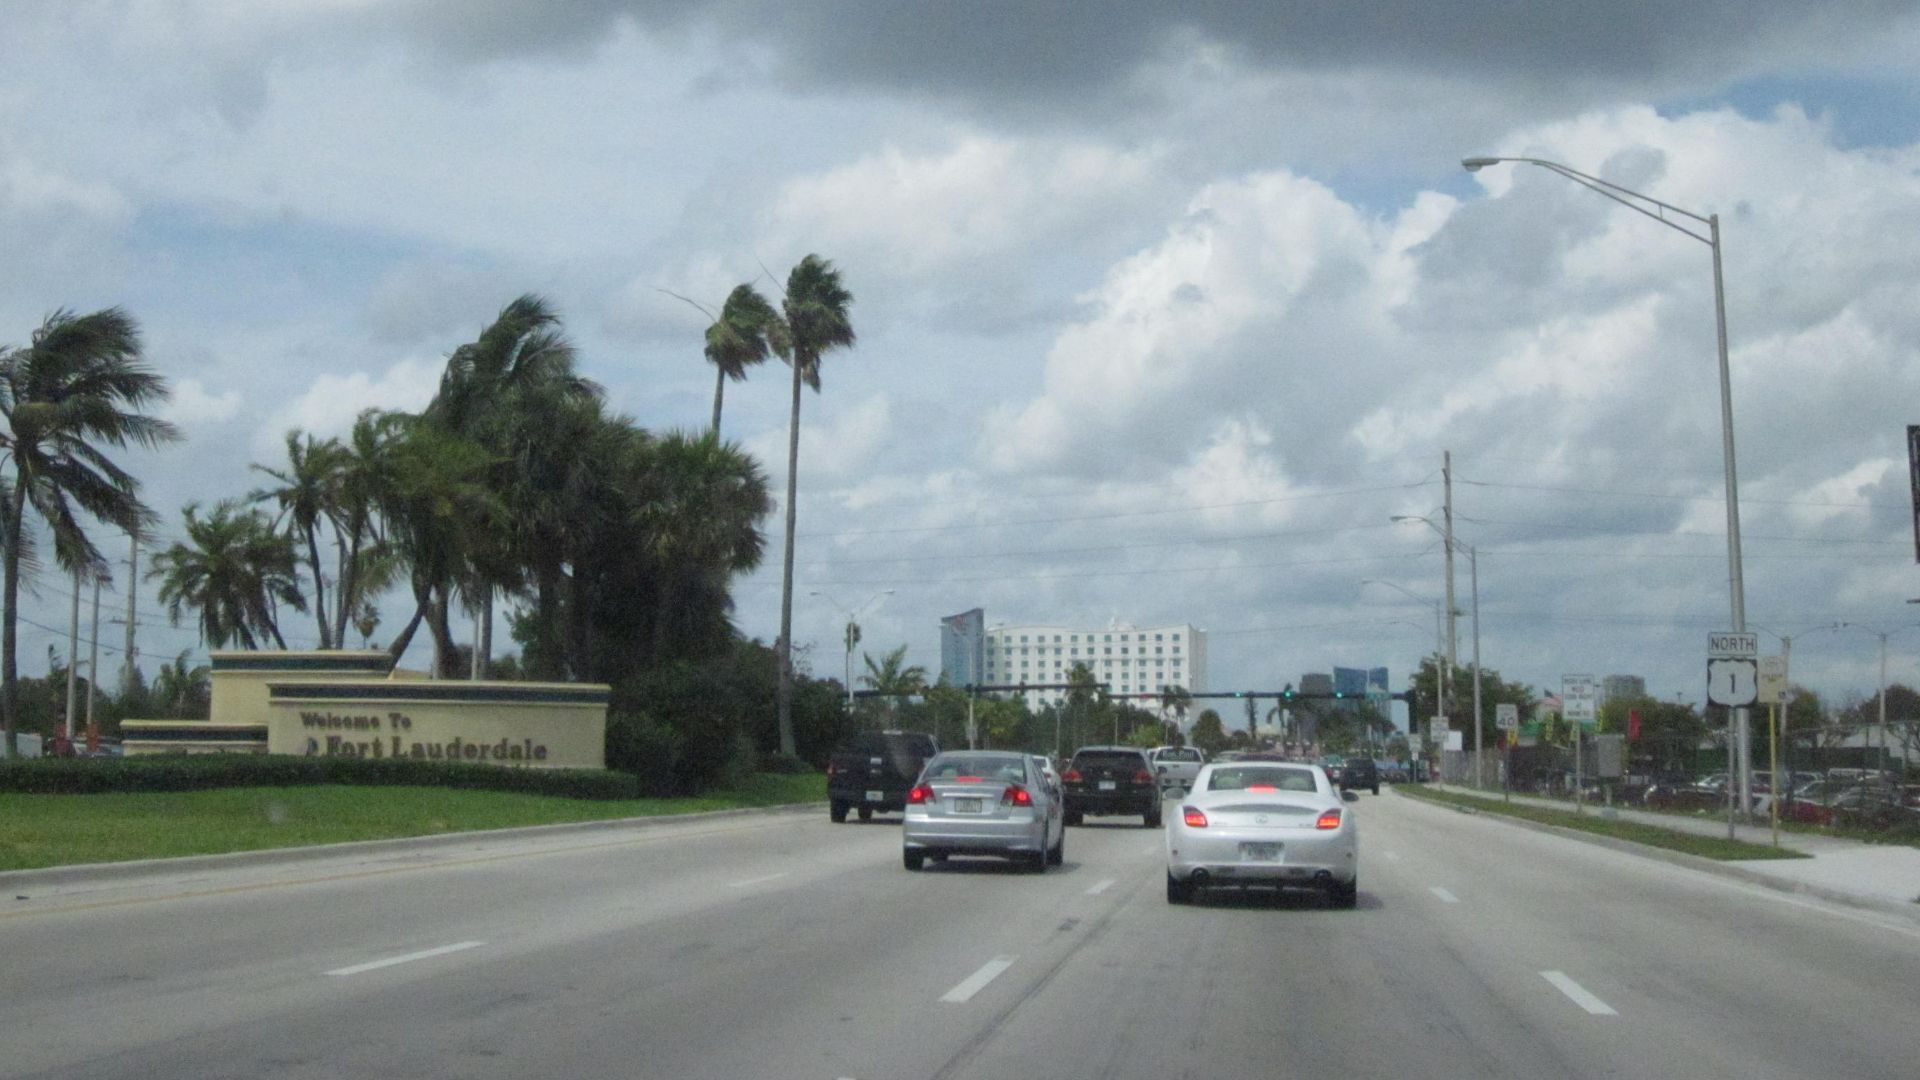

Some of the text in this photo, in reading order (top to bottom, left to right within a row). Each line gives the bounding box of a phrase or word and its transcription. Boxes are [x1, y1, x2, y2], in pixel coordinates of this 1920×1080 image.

[1711, 637, 1754, 651] NORTH
[1730, 673, 1736, 694] 1
[300, 711, 413, 729] Welcome To
[1498, 716, 1515, 727] 40
[326, 735, 548, 760] Fort Lauderdale
